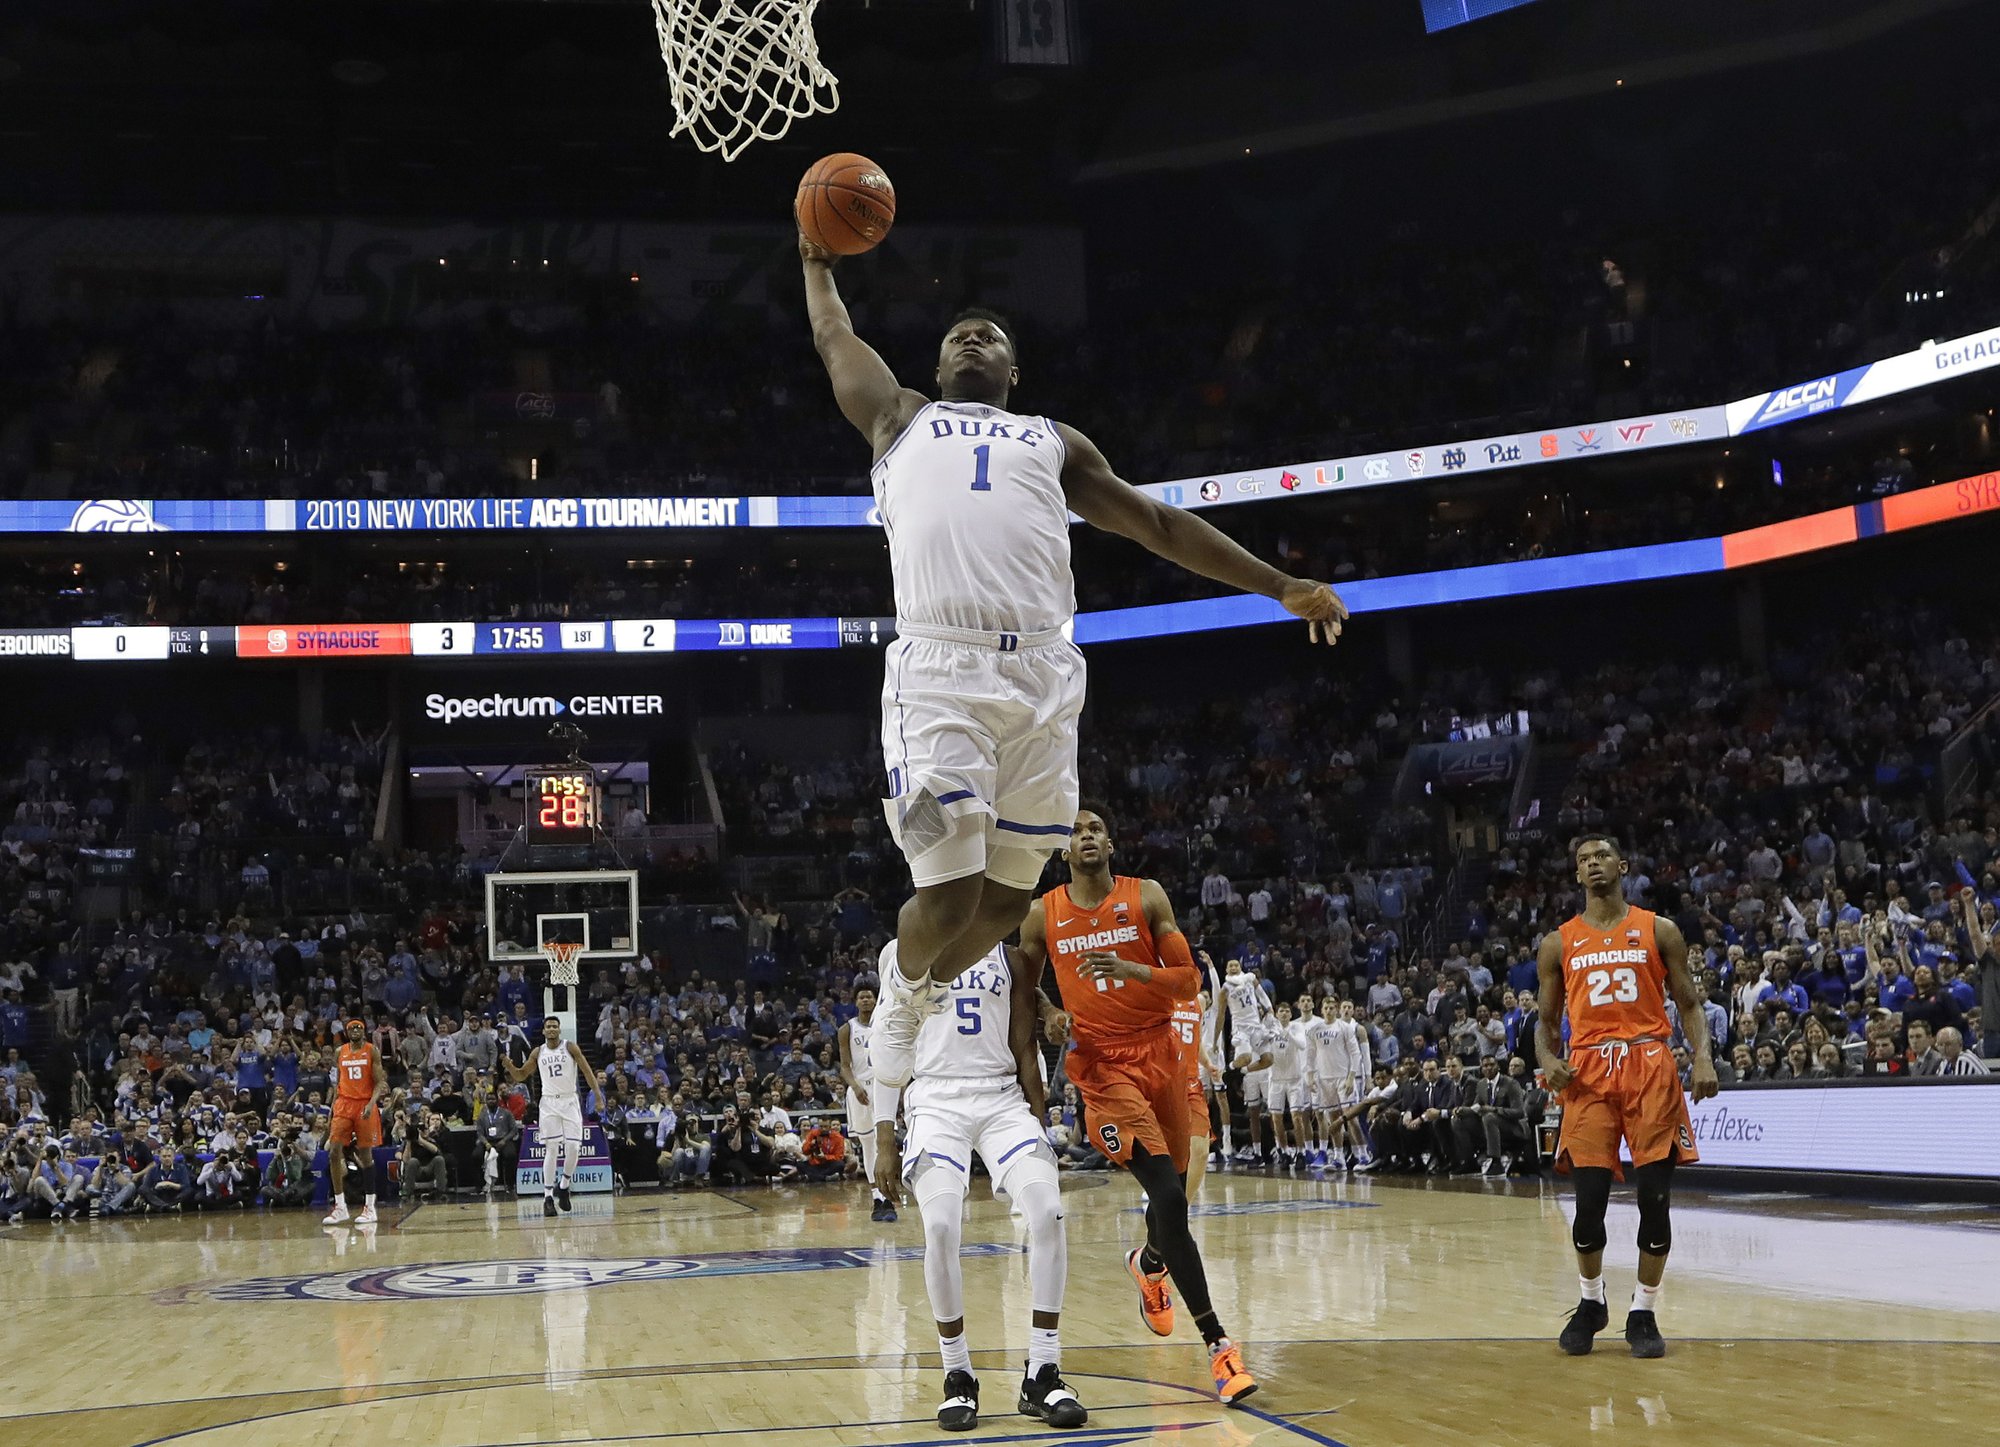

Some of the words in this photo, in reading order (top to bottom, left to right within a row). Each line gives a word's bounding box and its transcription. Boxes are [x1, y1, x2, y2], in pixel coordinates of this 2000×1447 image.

[1765, 377, 1837, 412] ACCN
[929, 418, 1044, 448] DUKE
[1484, 442, 1522, 464] Pitt
[970, 444, 992, 491] 1
[306, 500, 360, 529] 2019
[367, 500, 415, 529] NEW
[421, 499, 477, 528] YORK
[482, 499, 524, 527] LIFE
[529, 498, 578, 527] ACC
[580, 497, 740, 527] TOURNAMENT
[170, 631, 191, 642] FLS:
[574, 630, 592, 643] 1ST
[643, 625, 655, 647] 2
[750, 624, 792, 645] DUKE
[842, 621, 862, 632] FLS:
[843, 632, 863, 643] TOL:
[116, 635, 126, 652] 0
[171, 642, 192, 653] TOL:
[296, 630, 380, 649] SYRACUSE
[441, 627, 454, 651] 3
[491, 627, 543, 649] 17:55
[1000, 633, 1018, 651] D
[426, 693, 556, 724] Spectrum
[569, 695, 663, 715] CENTER
[541, 776, 586, 795] 17:55
[540, 796, 580, 827] 28
[1056, 925, 1140, 955] SYRACUSE
[1570, 949, 1648, 971] SYRACUSE
[950, 970, 1006, 997] UKE
[1587, 967, 1639, 1007] 23
[1239, 994, 1253, 1008] 14
[955, 997, 982, 1036] 5
[541, 1055, 567, 1066] DUKE
[548, 1064, 563, 1078] 12
[347, 1066, 362, 1080] 13
[1099, 1123, 1122, 1154] S
